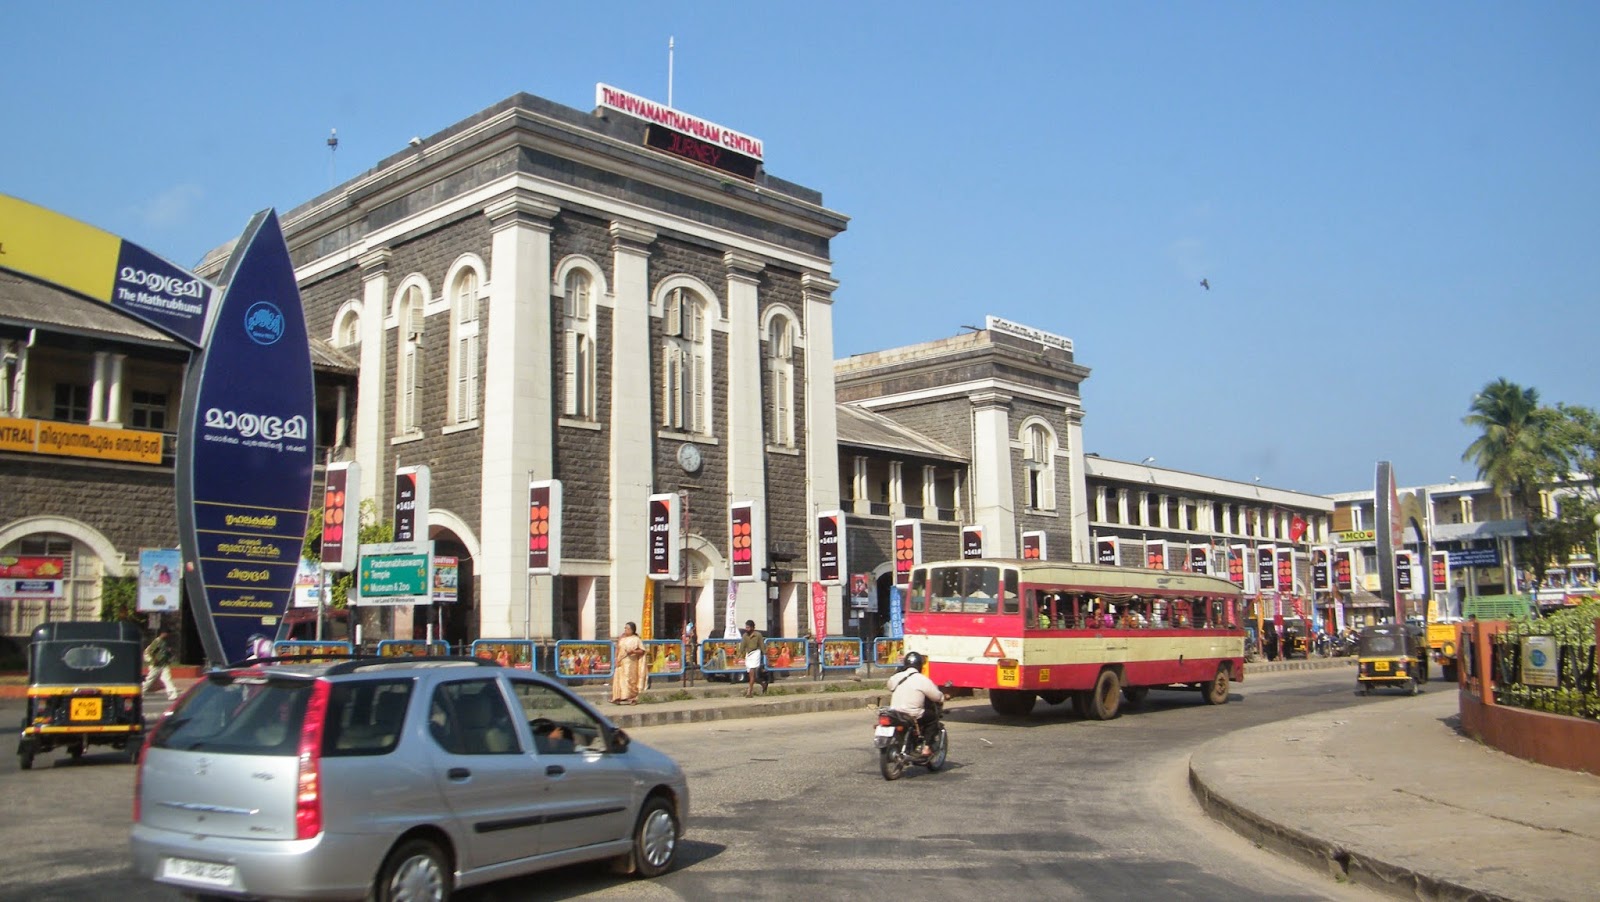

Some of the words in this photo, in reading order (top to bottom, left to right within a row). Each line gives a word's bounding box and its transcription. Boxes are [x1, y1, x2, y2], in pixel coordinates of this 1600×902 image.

[602, 87, 719, 143] THIRUVANANTHAPURAM
[722, 130, 763, 157] CENTRAL
[118, 287, 136, 303] The
[137, 292, 202, 315] Mathrubhumi
[204, 407, 308, 441] മാതൃഭൂമി
[1345, 531, 1366, 540] MCO
[371, 570, 391, 580] Temple
[370, 583, 394, 592] Museum
[398, 582, 410, 591] Zoo
